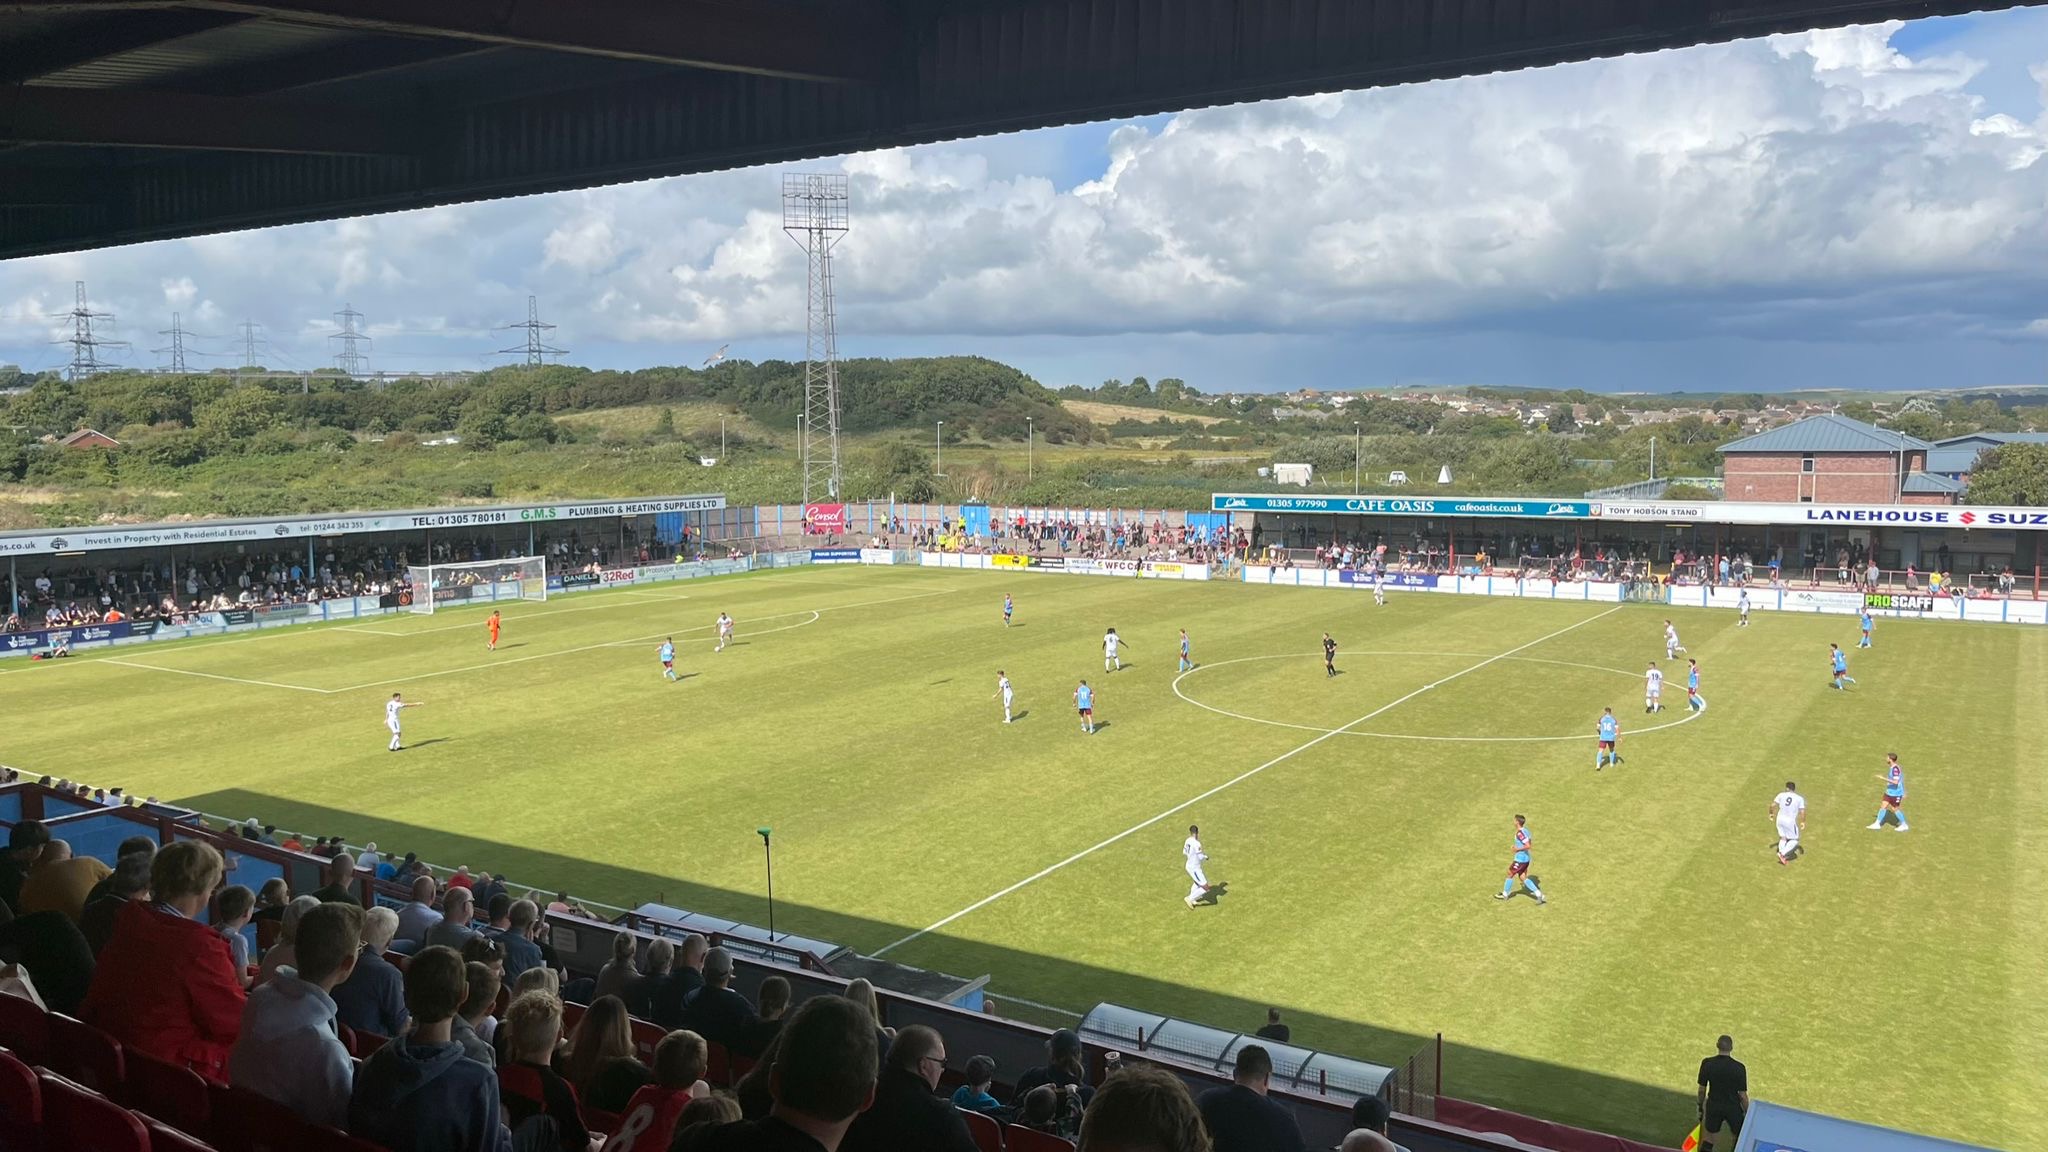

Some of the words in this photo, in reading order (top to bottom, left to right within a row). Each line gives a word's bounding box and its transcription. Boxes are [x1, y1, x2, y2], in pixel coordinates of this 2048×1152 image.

[569, 505, 613, 517] PLUMBING
[617, 505, 624, 514] &
[625, 502, 662, 513] HEATING
[663, 500, 701, 511] SUPPLIES
[702, 500, 717, 508] LTD
[1266, 499, 1292, 508] 01305
[1295, 499, 1327, 509] 977990
[1346, 500, 1386, 512] CAFE
[1390, 501, 1435, 513] OASIS
[1454, 502, 1525, 513] cafeoasis.co.uk
[520, 507, 557, 520] G.M.S
[805, 506, 842, 521] Consol
[1633, 507, 1668, 515] HOBSON
[1671, 508, 1698, 516] STAND
[1806, 509, 1949, 523] LANEHOUSE
[1987, 513, 2048, 525] SUZ
[412, 517, 436, 527] TEL:
[438, 514, 469, 525] 01305
[472, 512, 507, 523] 780181
[313, 522, 336, 531] 01244
[337, 522, 350, 530] 343
[351, 521, 364, 529] 355
[84, 537, 112, 546] Invest
[113, 536, 122, 544] in
[124, 534, 162, 545] Property
[163, 532, 182, 541] with
[183, 529, 228, 540] Residential
[229, 528, 257, 537] Estates
[1105, 561, 1126, 570] WFC
[563, 573, 598, 583] DANIELS
[603, 571, 634, 583] 32Red
[1865, 594, 1933, 609] PROSCAFF
[1651, 673, 1659, 681] 19
[1785, 796, 1793, 807] 9
